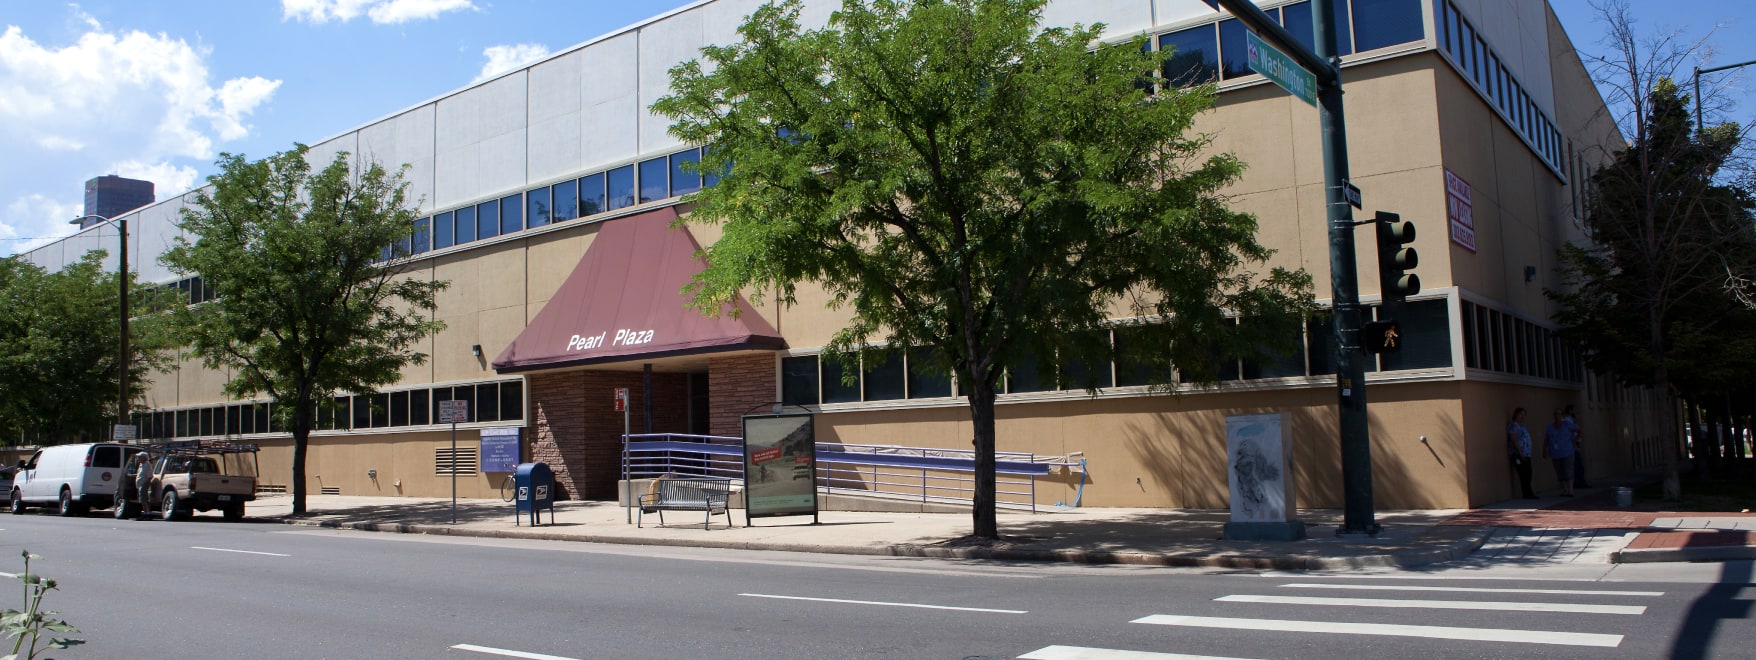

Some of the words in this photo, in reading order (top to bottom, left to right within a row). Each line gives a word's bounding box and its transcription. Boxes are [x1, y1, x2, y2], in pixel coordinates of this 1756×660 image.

[1260, 46, 1304, 95] Washington
[566, 331, 607, 352] Pearl
[612, 328, 655, 347] Plaza
